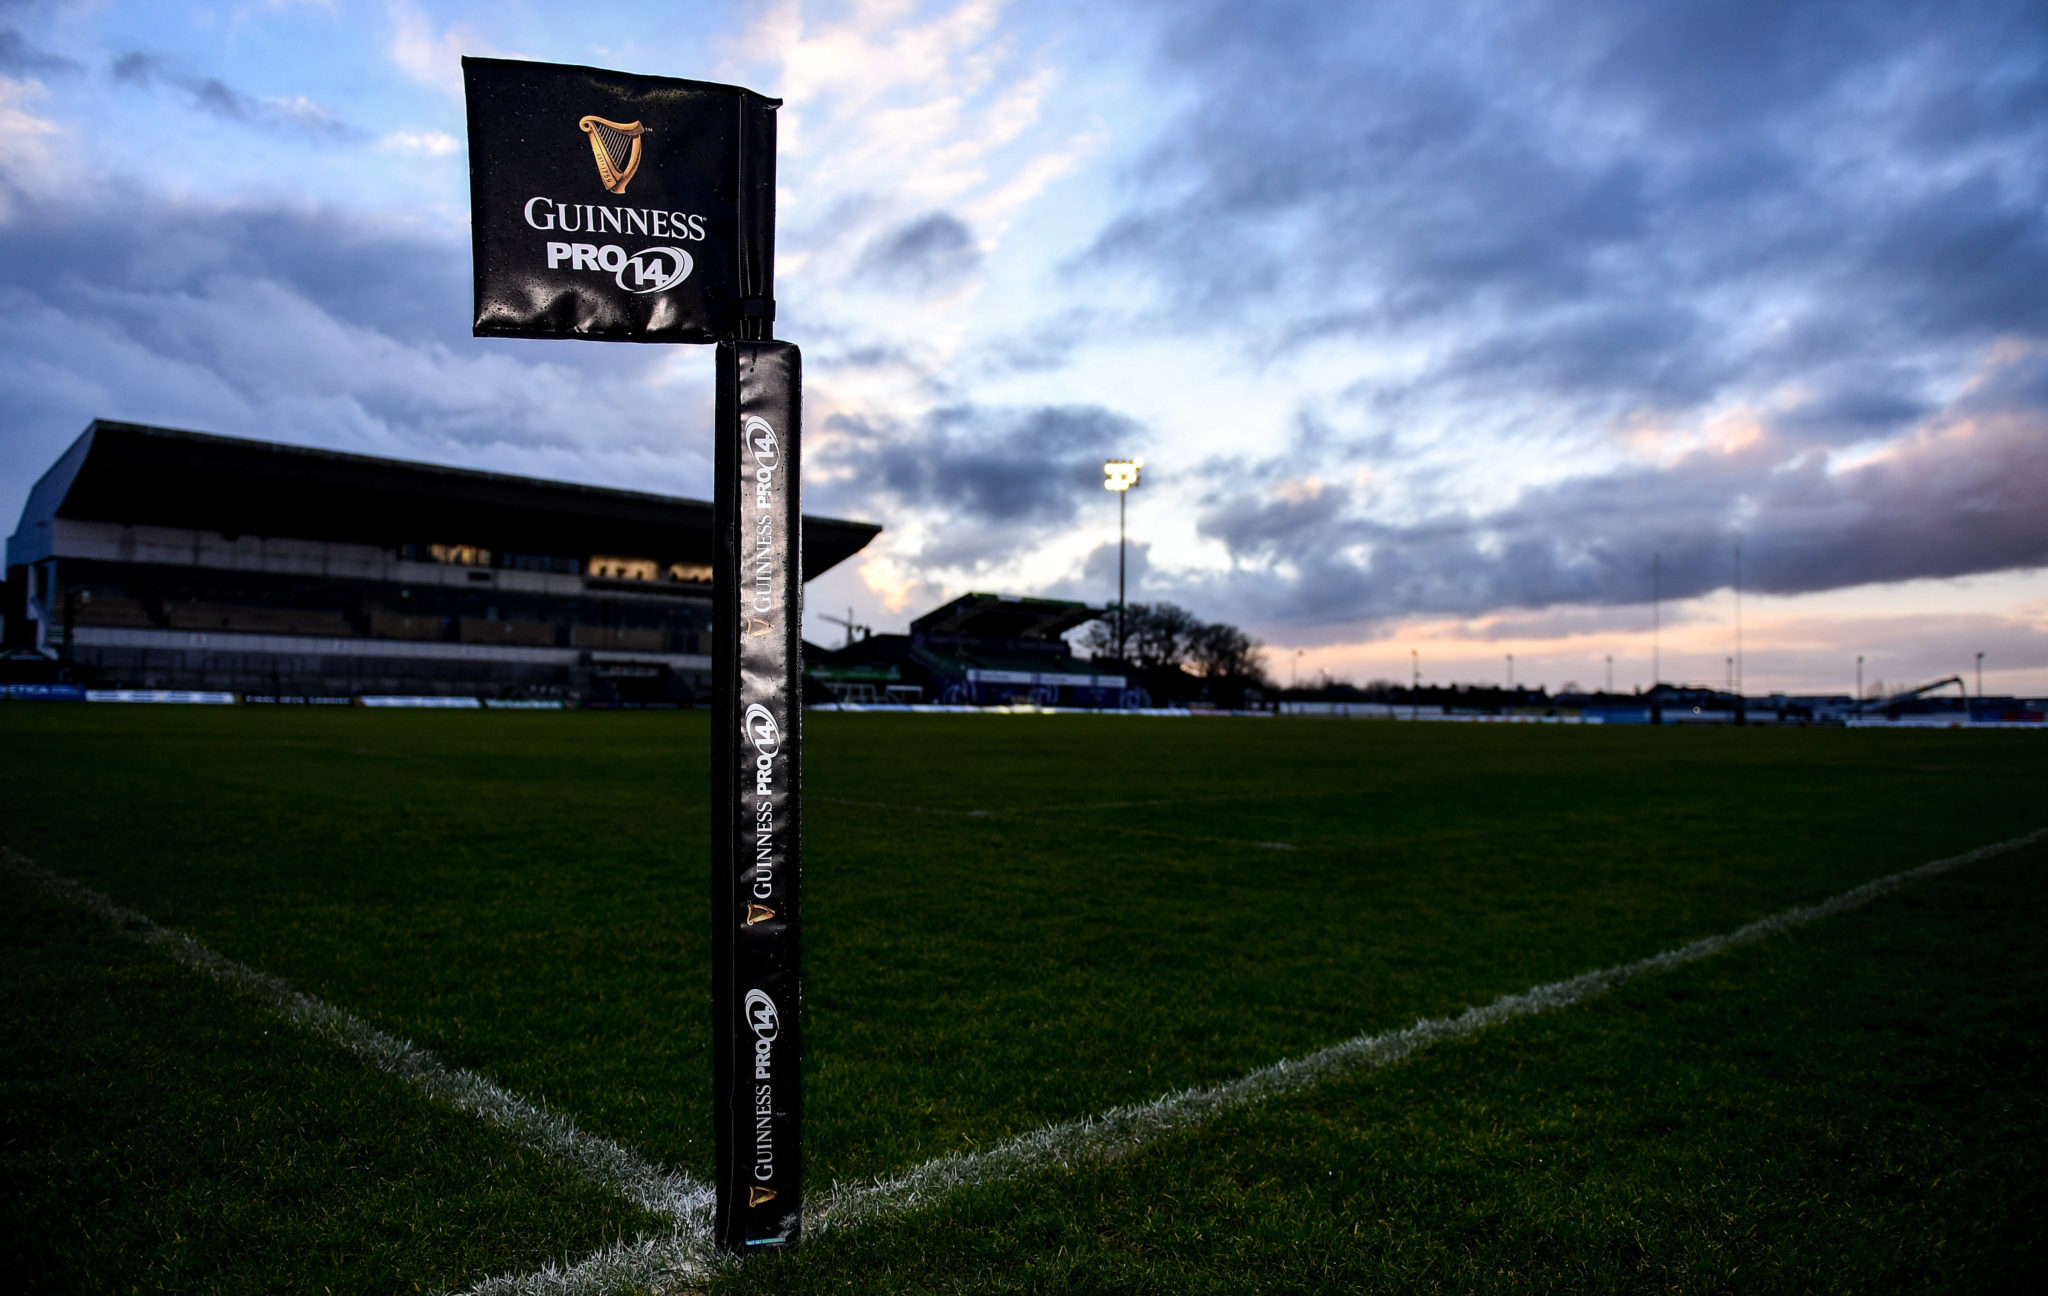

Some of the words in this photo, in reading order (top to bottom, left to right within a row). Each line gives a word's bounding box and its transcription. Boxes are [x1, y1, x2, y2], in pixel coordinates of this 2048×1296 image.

[525, 196, 706, 242] GUINNESS
[753, 514, 773, 613] GUINNESS
[753, 801, 773, 900] GUINNESS
[754, 1085, 774, 1180] GUINNESS
